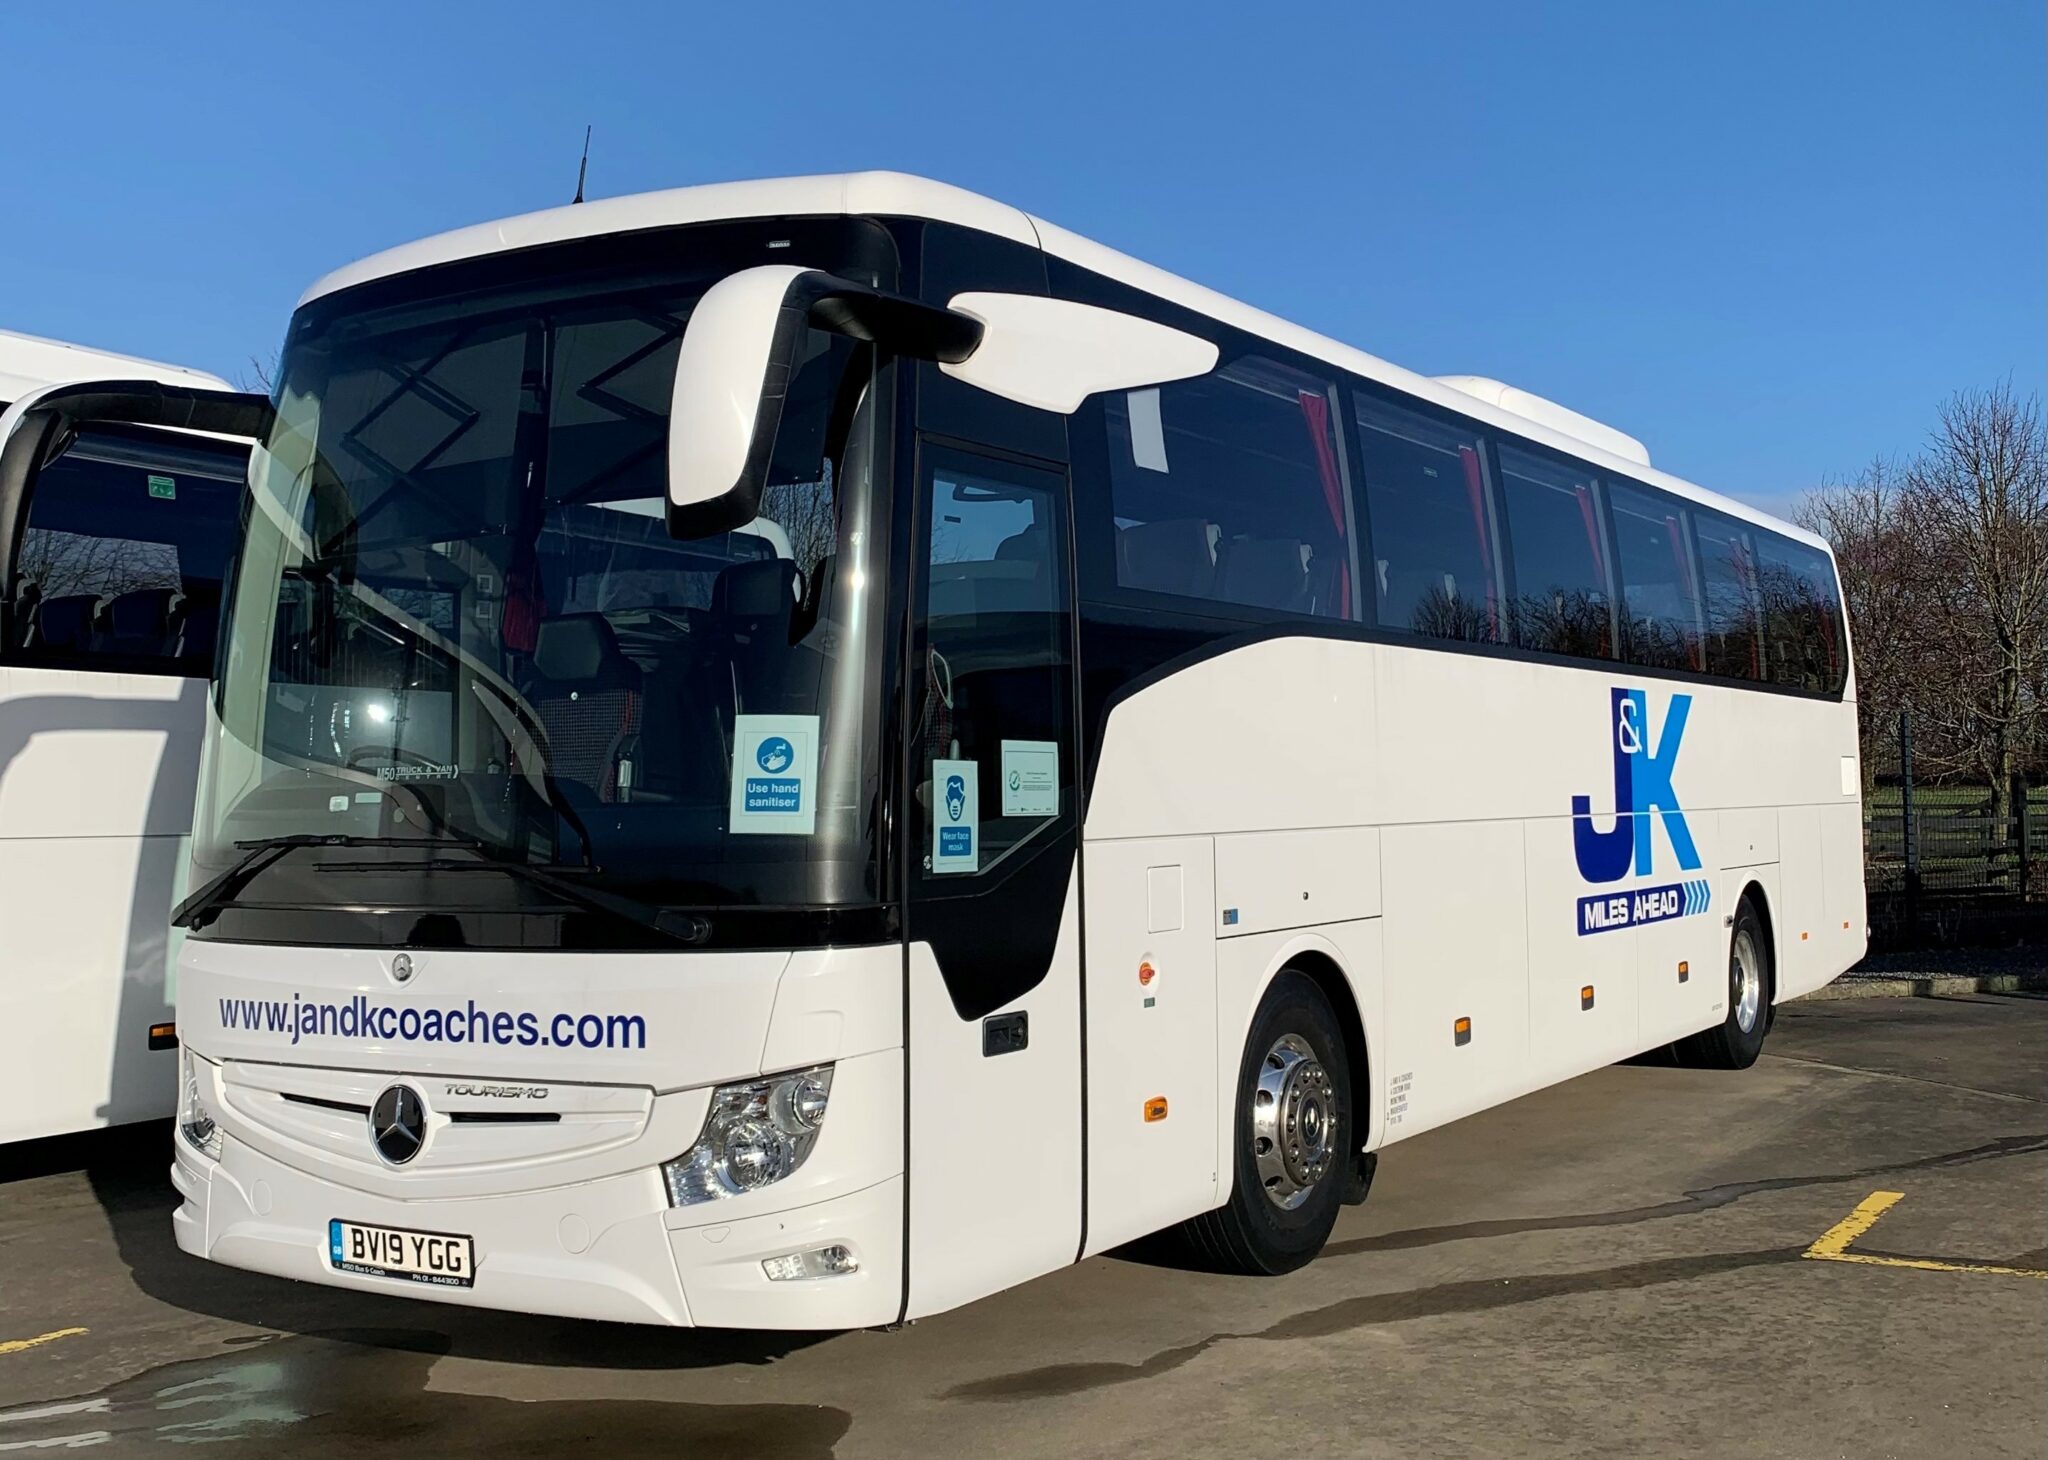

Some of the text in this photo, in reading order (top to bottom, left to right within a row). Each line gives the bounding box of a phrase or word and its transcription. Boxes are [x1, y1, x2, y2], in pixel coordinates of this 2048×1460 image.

[376, 767, 395, 780] M50
[397, 766, 422, 774] TRUCK
[747, 783, 799, 793] Use hand
[749, 797, 796, 807] sanitiser
[943, 832, 969, 840] Wear face
[948, 843, 963, 851] mask
[1584, 890, 1679, 930] MILES AHEAD
[219, 992, 647, 1049] www.jandkcoaches.com
[445, 1083, 549, 1099] TOURISMO
[333, 1245, 342, 1255] GB
[351, 1228, 462, 1273] BV19 YGG
[355, 1264, 364, 1273] Bus
[370, 1267, 386, 1276] Coach
